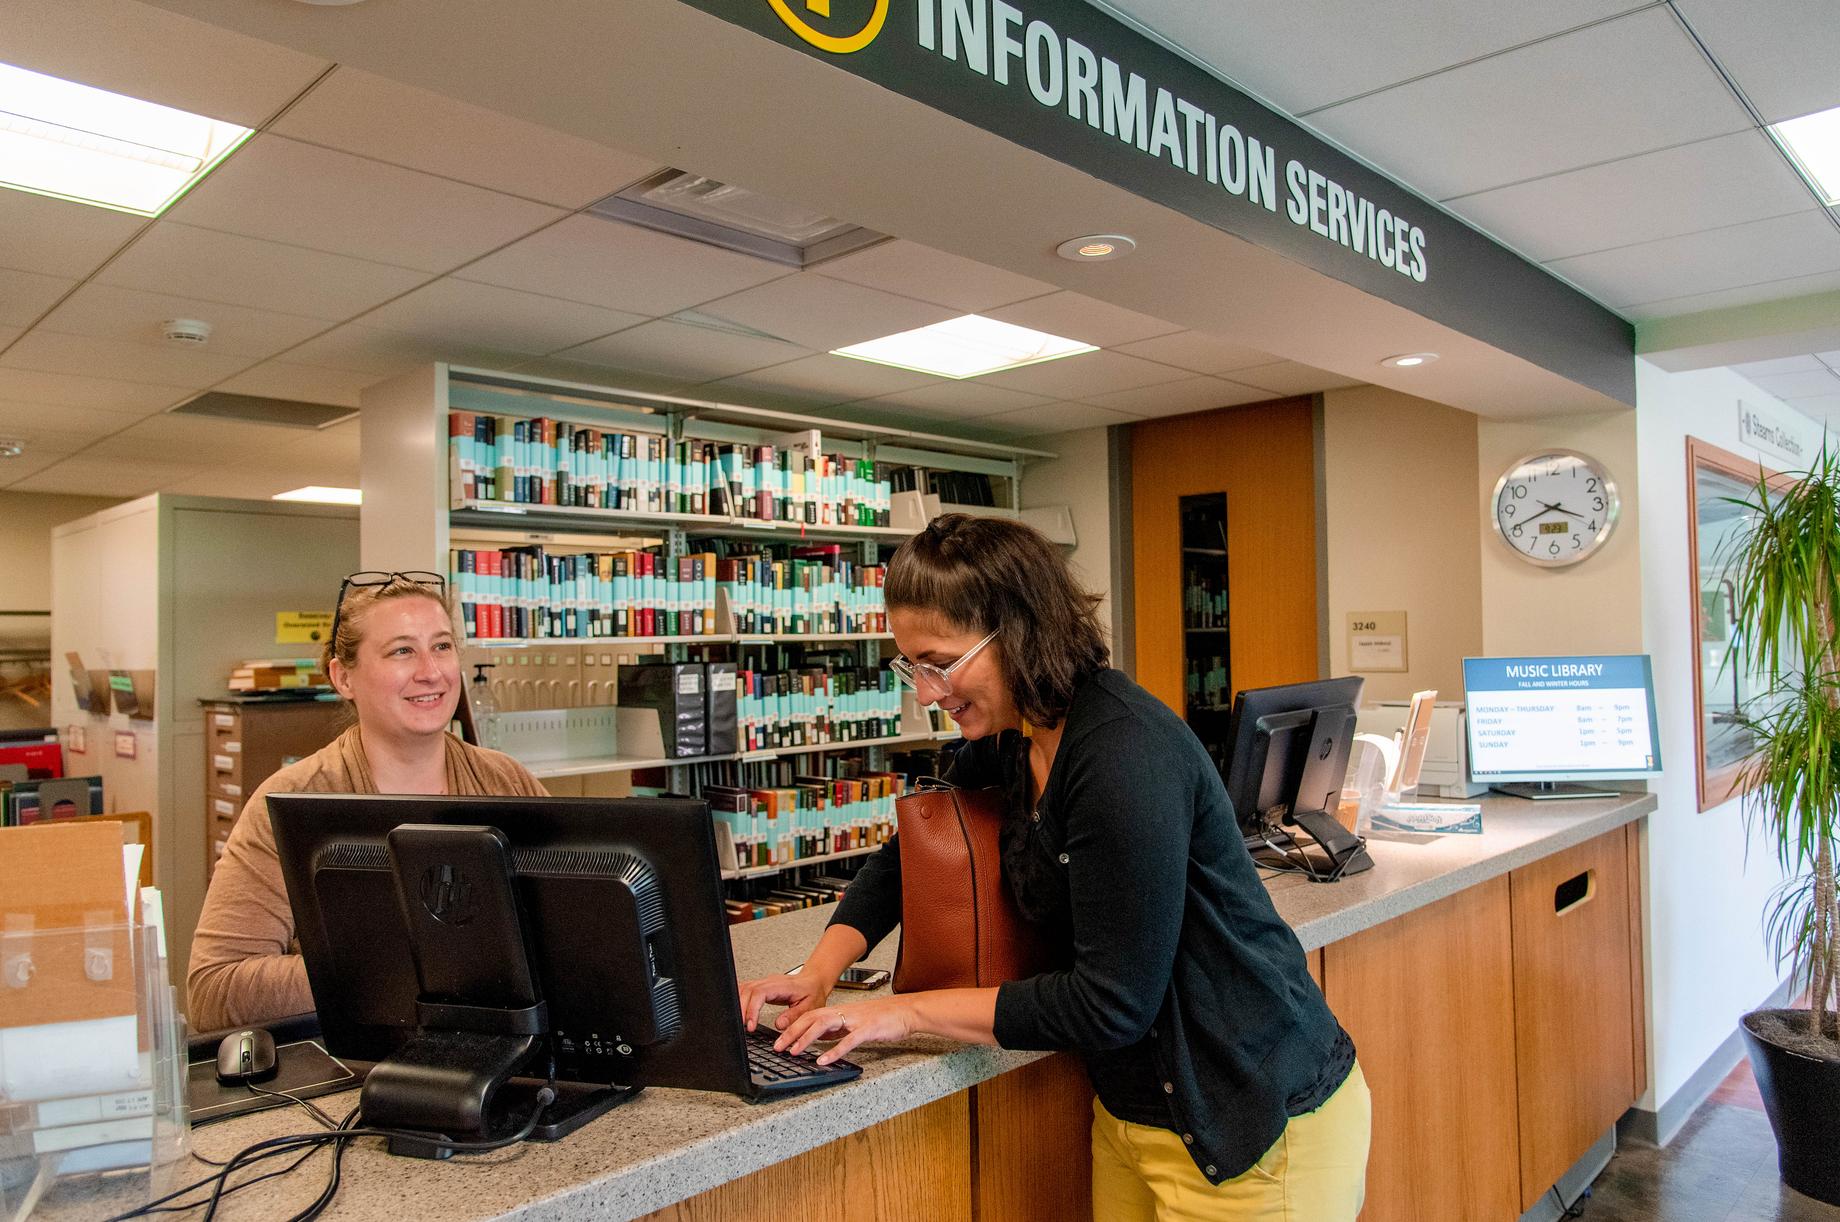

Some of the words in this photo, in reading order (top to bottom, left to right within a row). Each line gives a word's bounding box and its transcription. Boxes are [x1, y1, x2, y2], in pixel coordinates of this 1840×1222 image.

[917, 0, 1276, 212] INFORMATION
[1284, 159, 1428, 283] SERVICES
[1511, 484, 1528, 500] 10
[1585, 477, 1597, 493] 2
[1505, 504, 1515, 518] 9
[1592, 496, 1604, 512] 3
[1512, 524, 1523, 537] 8
[1587, 517, 1596, 532] 4
[1531, 535, 1538, 551] 7
[1549, 540, 1560, 554] 6
[1571, 533, 1581, 549] 5
[1352, 622, 1376, 631] 3240
[1506, 665, 1549, 678] MUSIC
[1551, 664, 1603, 677] LIBRARY
